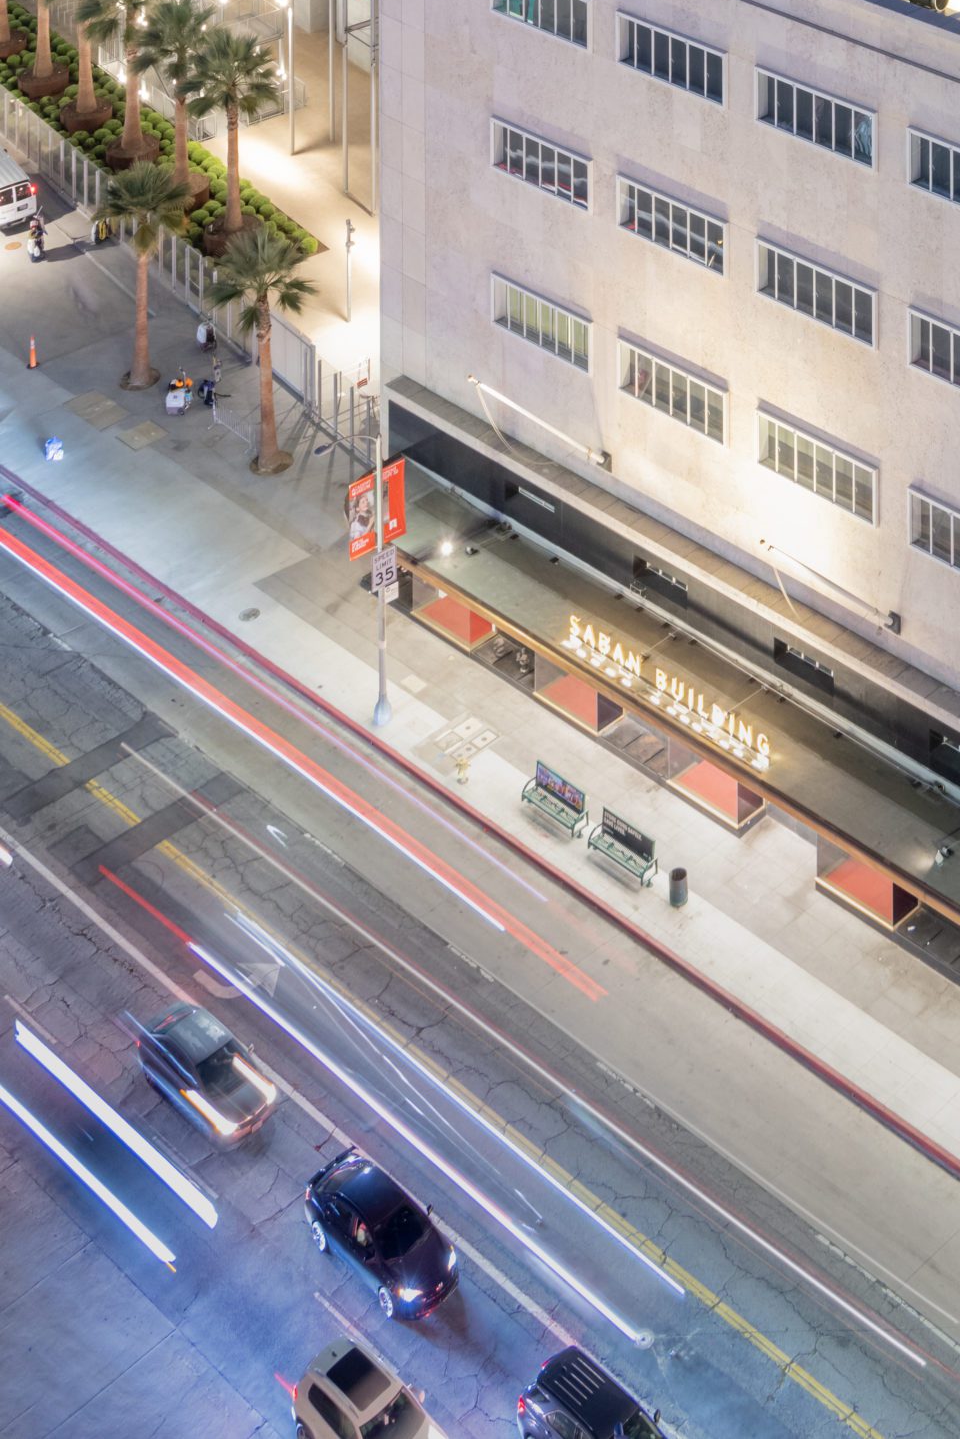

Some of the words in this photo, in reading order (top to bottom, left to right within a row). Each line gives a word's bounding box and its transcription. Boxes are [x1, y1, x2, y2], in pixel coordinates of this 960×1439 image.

[374, 549, 395, 564] SPEED
[375, 558, 393, 571] LIMIT
[375, 566, 394, 586] 35
[569, 614, 641, 677] SABAN
[655, 667, 770, 756] BUILDING
